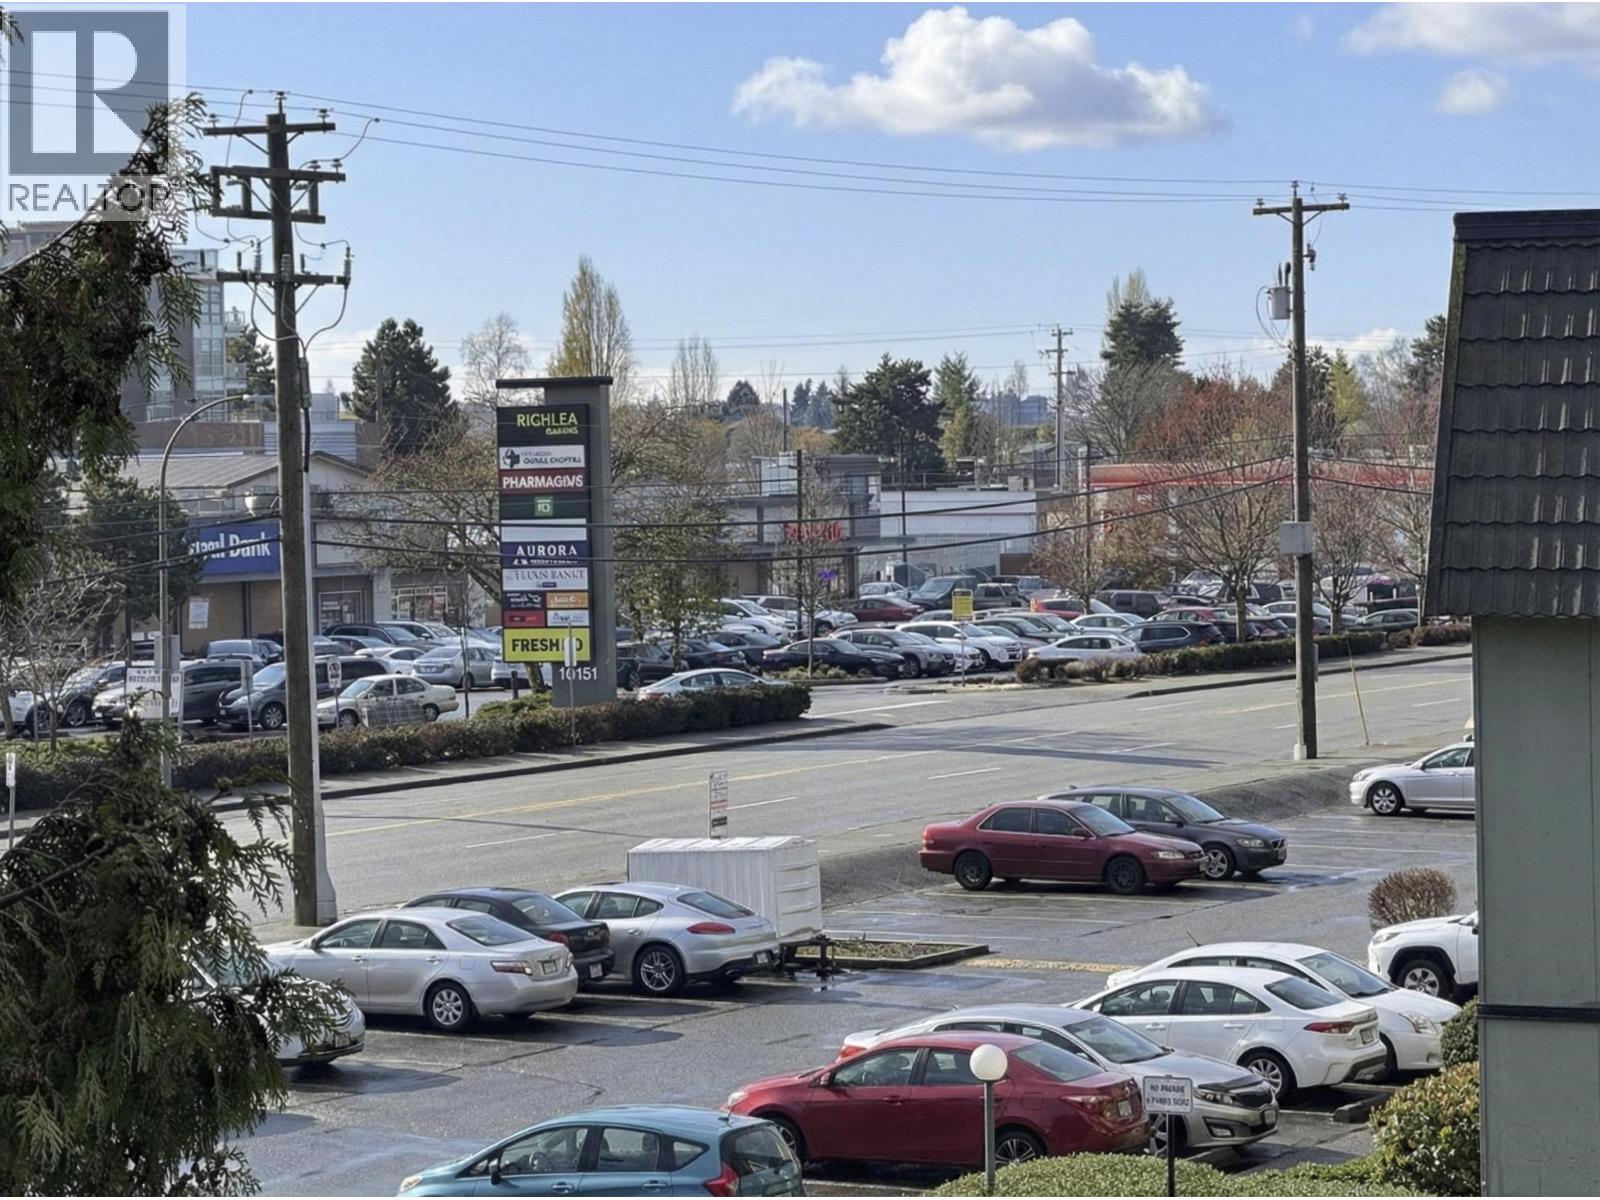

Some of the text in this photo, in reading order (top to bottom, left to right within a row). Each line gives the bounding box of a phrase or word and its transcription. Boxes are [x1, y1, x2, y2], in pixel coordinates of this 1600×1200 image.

[516, 544, 578, 557] AURORA
[511, 638, 584, 652] FRESHO
[559, 667, 598, 681] 10151
